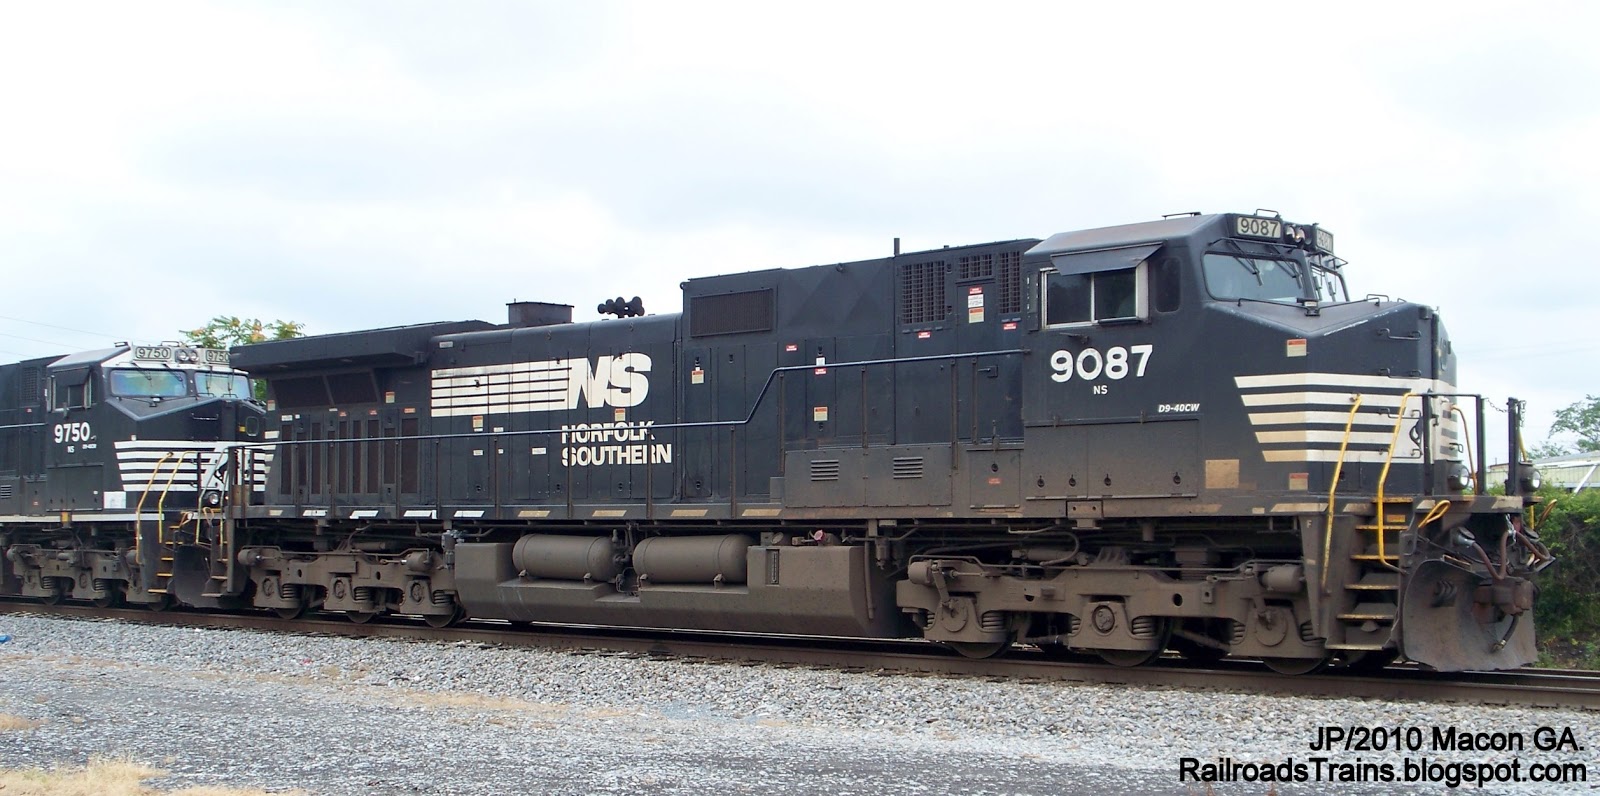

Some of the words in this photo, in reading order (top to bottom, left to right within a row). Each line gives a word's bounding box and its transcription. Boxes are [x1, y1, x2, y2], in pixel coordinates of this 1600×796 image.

[1240, 217, 1279, 237] 9087
[138, 347, 168, 358] 9750
[1050, 344, 1153, 383] 9087
[567, 352, 652, 410] NS
[1093, 385, 1108, 395] NS
[1158, 403, 1201, 414] D9-40CW
[54, 421, 91, 443] 9750
[67, 445, 75, 453] NS
[561, 443, 672, 467] SOUTHERN
